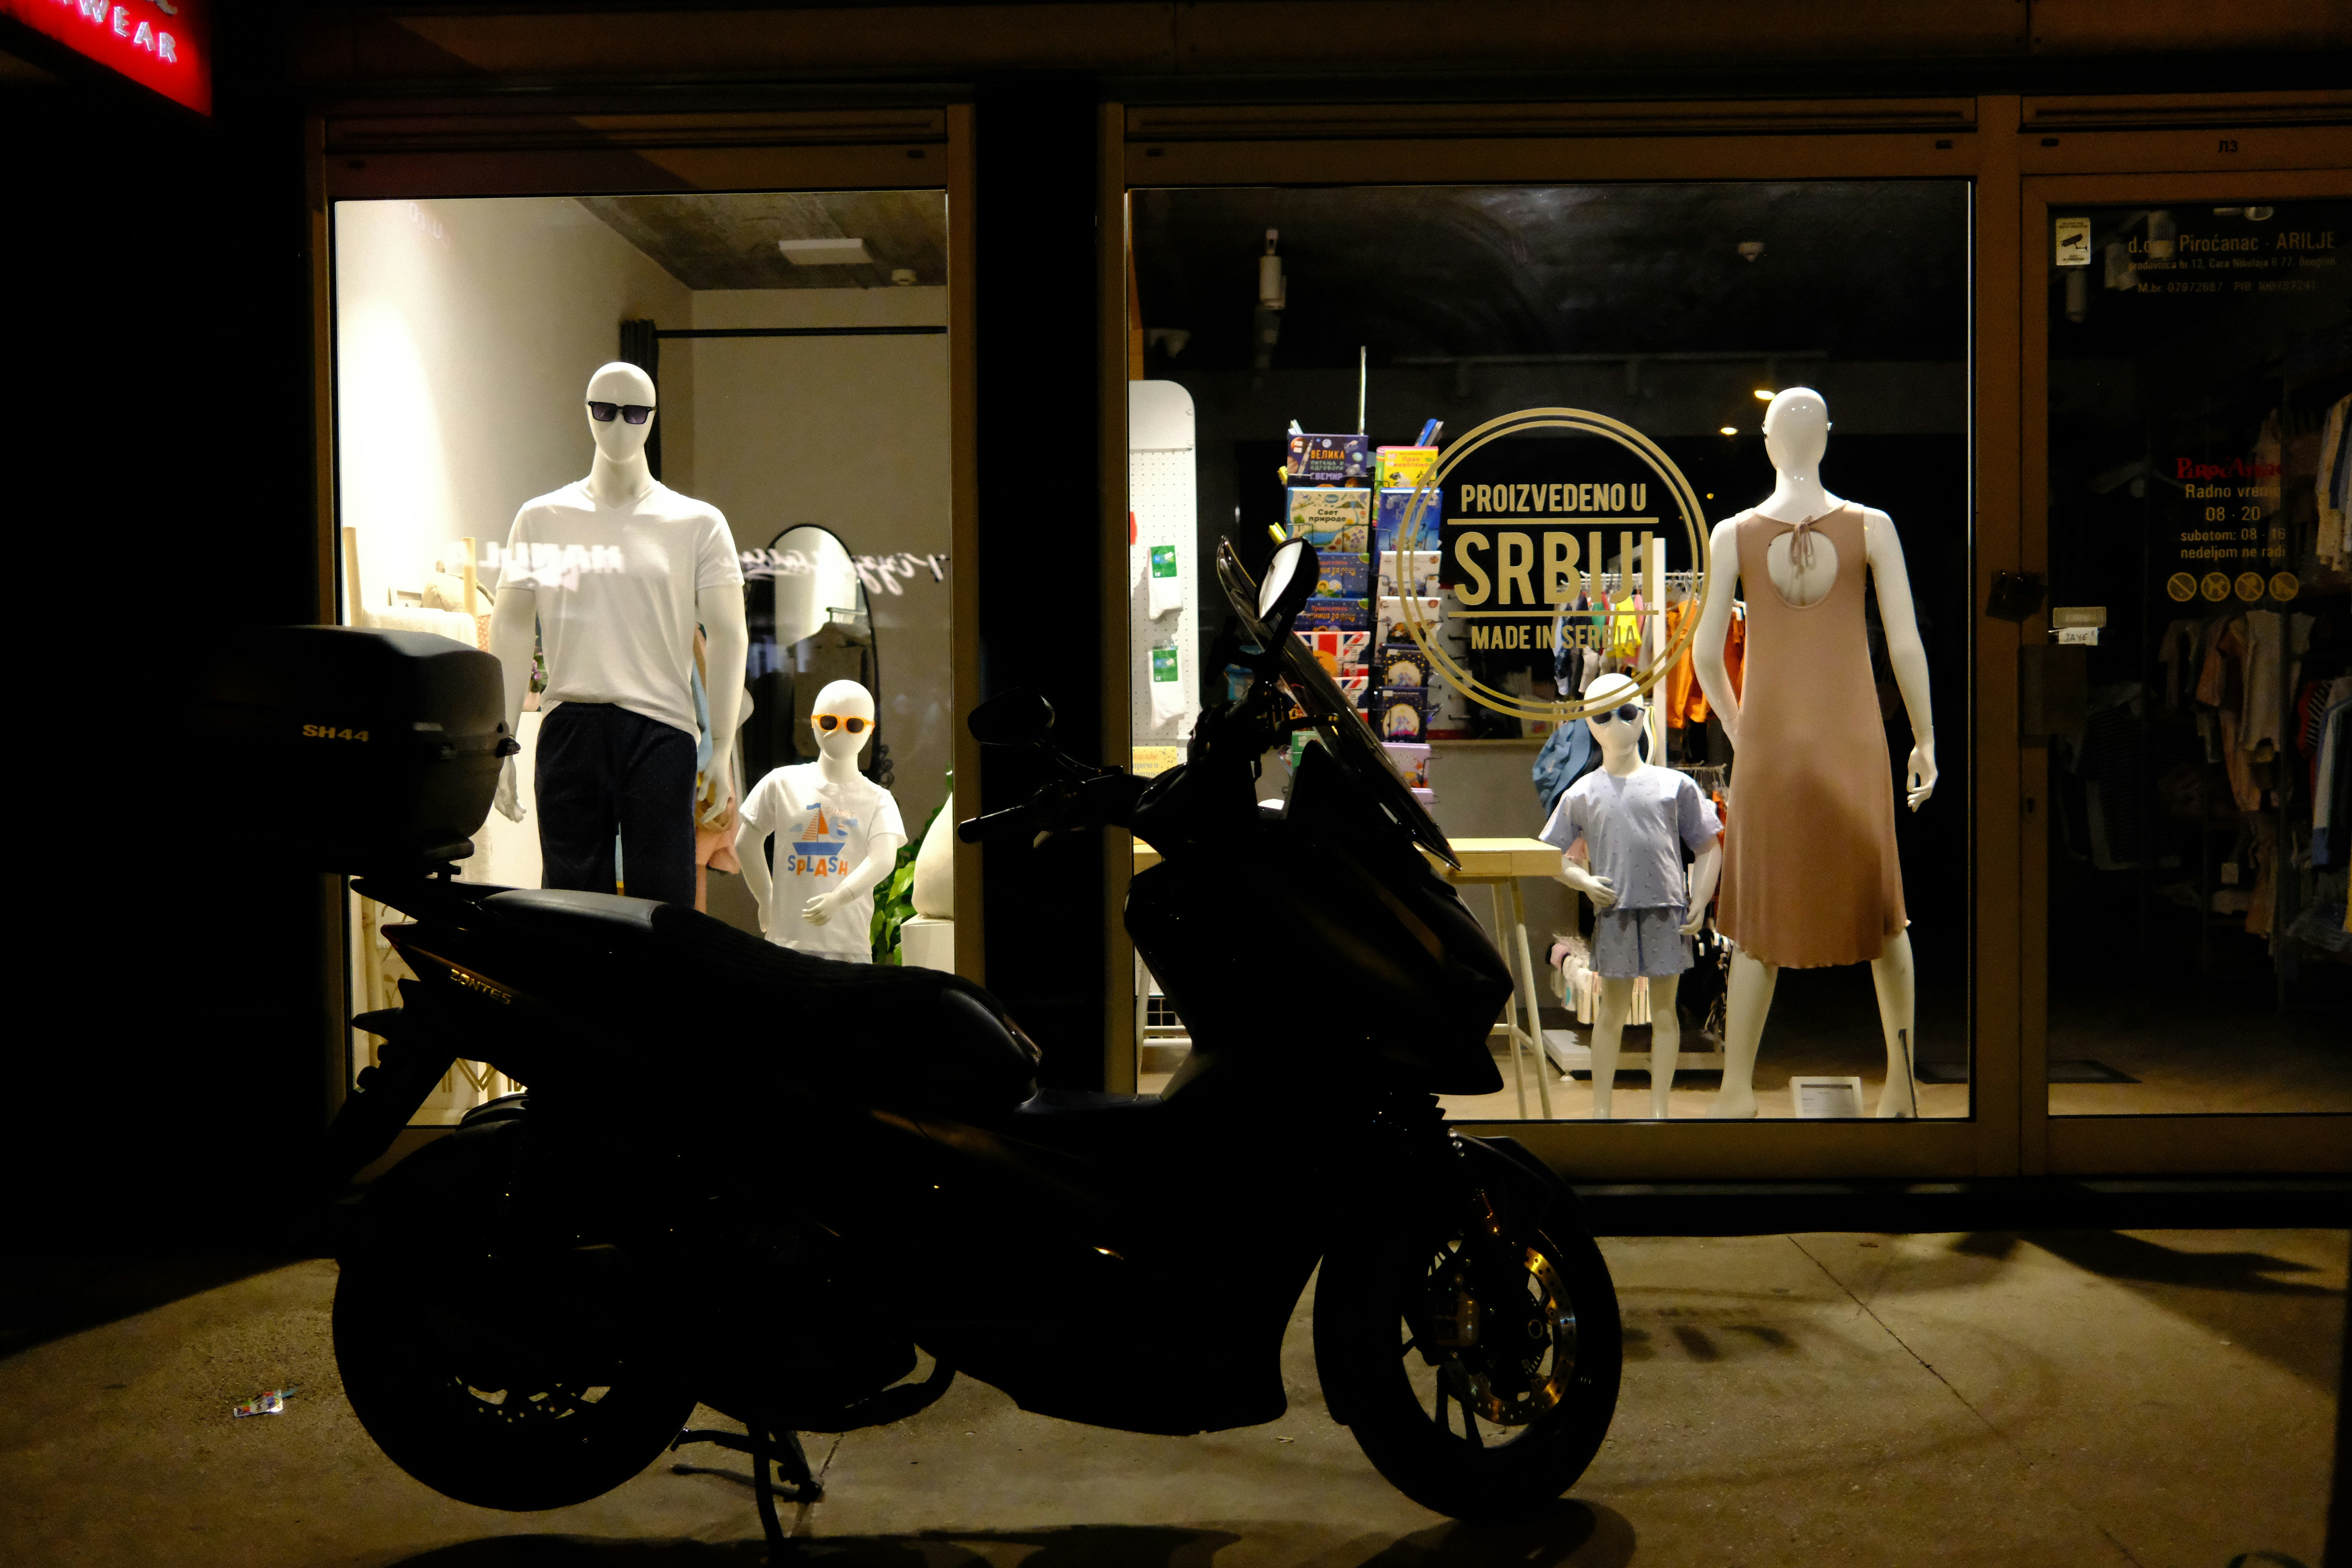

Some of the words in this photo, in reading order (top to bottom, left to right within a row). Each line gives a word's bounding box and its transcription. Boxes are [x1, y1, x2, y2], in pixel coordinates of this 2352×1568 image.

[2179, 234, 2258, 252] Piroćanac
[2276, 231, 2336, 250] ARILJE
[1311, 449, 1345, 459] ВЕЛИКА
[1461, 483, 1625, 512] PROIZVEDENO
[1632, 483, 1647, 511] U
[2185, 484, 2232, 498] Radno
[2205, 506, 2226, 521] 08
[2241, 506, 2261, 521] 20
[2180, 529, 2237, 542] subotom:
[2241, 527, 2258, 541] 08
[2180, 545, 2238, 561] nedeljom
[2241, 547, 2257, 558] ne
[2261, 545, 2286, 557] radi
[1454, 531, 1653, 606] SRBIJI
[1471, 625, 1531, 649] MADE
[1536, 625, 1556, 649] IN
[1562, 624, 1637, 649] SERBIA
[302, 724, 370, 742] SH44
[787, 854, 848, 877] SPLASH
[450, 968, 512, 1006] ZONTES
